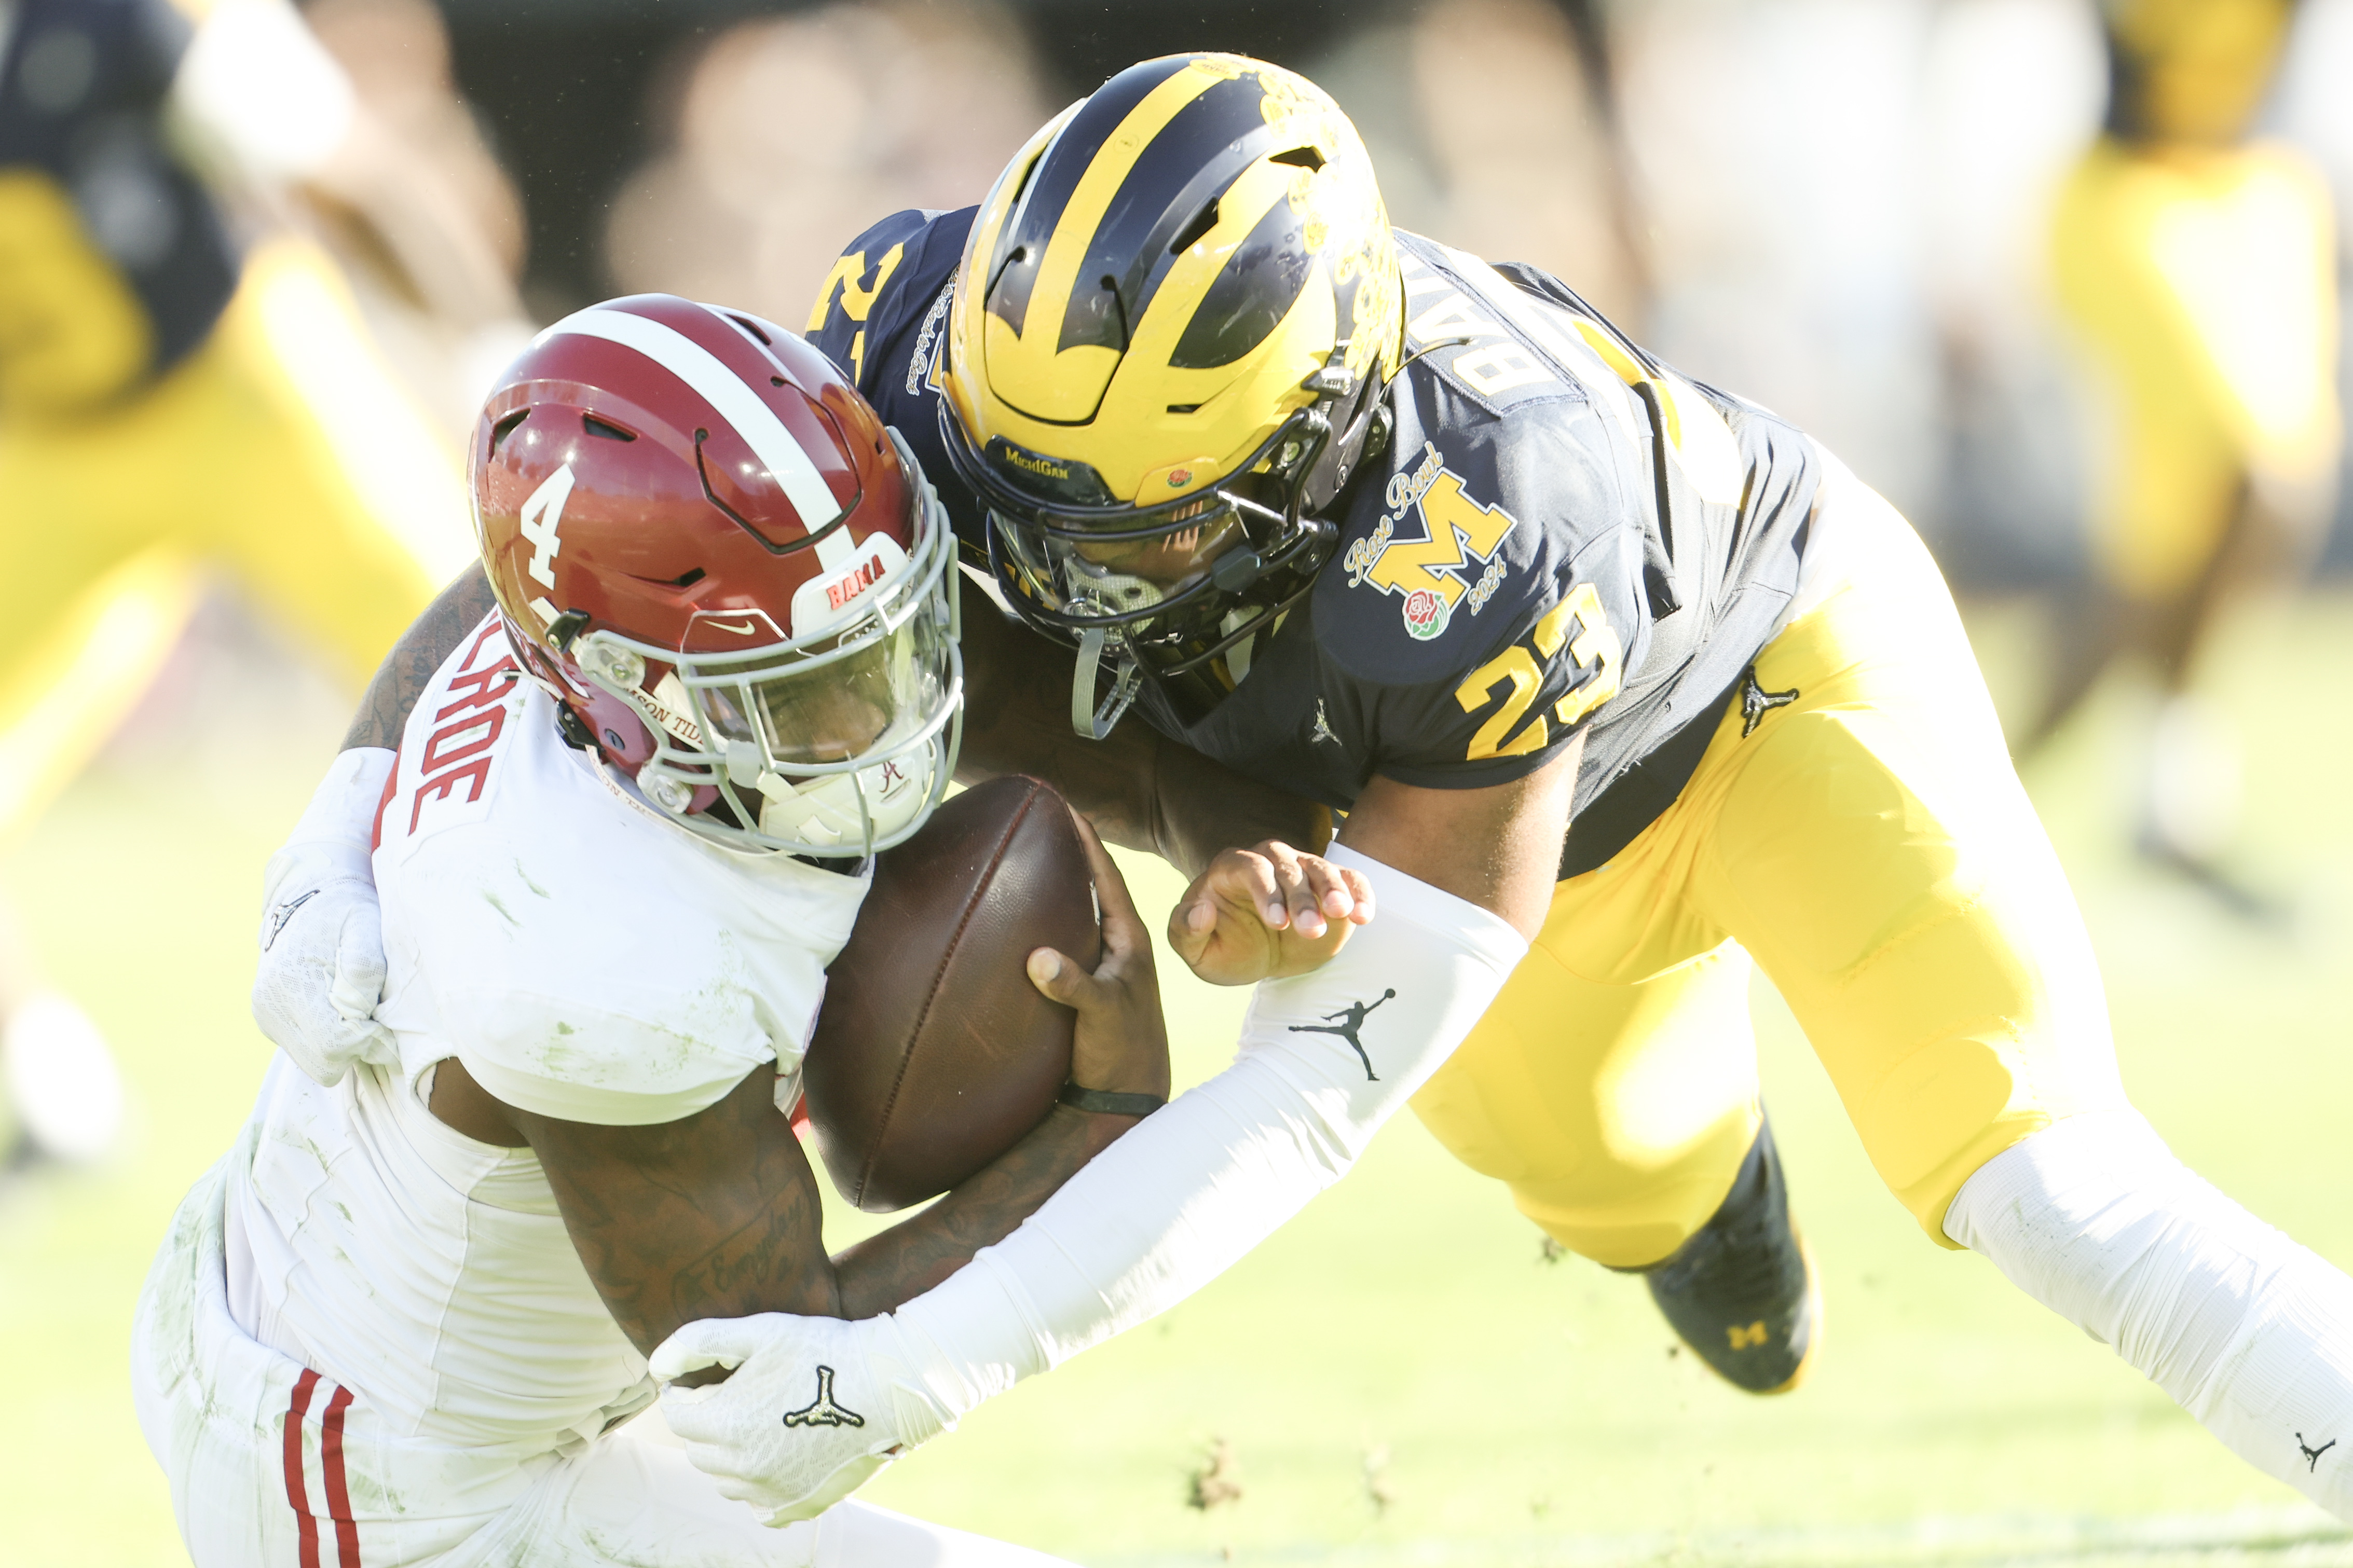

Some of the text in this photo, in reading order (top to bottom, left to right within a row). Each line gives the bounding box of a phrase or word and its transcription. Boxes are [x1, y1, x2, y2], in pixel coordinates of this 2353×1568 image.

[917, 334, 930, 352] to
[921, 296, 947, 339] Back
[906, 347, 928, 396] Back
[521, 463, 576, 591] 4
[1344, 441, 1443, 588] Rose Bowl
[1363, 467, 1518, 613] M
[826, 554, 885, 610] BAMA
[1467, 553, 1508, 616] 2024
[1454, 582, 1622, 761] 23
